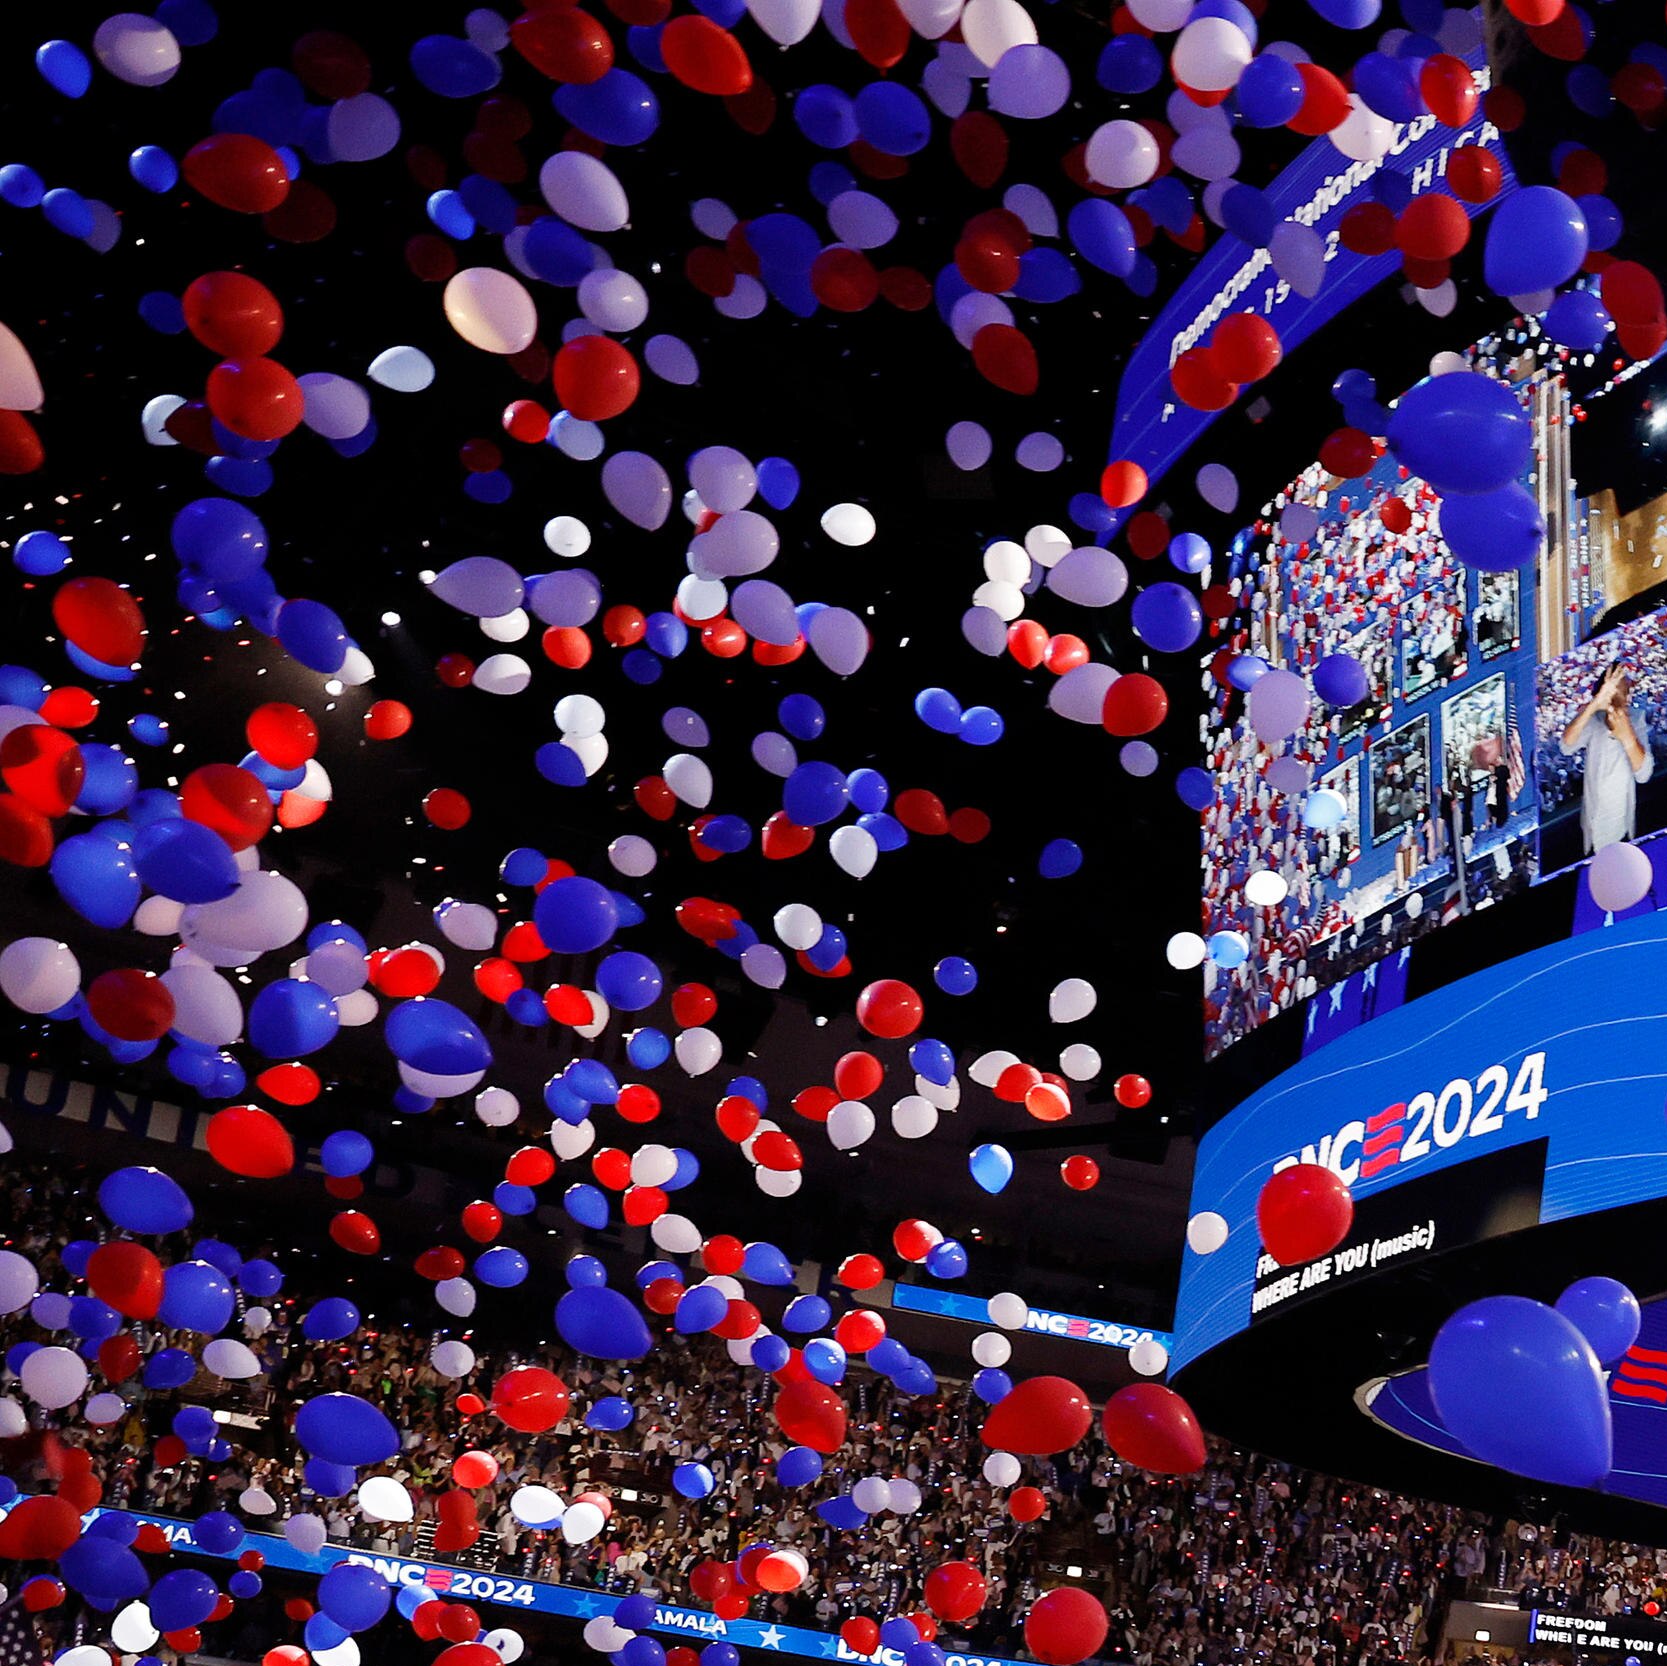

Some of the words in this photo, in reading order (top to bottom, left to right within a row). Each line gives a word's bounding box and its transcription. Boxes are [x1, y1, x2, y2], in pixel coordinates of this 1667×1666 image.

[1398, 1051, 1548, 1163] 2024
[1252, 1272, 1300, 1314] WHERE
[1299, 1258, 1333, 1291] ARE
[1334, 1243, 1370, 1276] YOU
[1370, 1219, 1436, 1268] (music)
[1026, 1310, 1070, 1335] NC
[451, 1575, 535, 1606] 2024
[654, 1609, 728, 1636] AMALA
[1590, 1633, 1622, 1649] ARE
[1624, 1637, 1653, 1653] YOU
